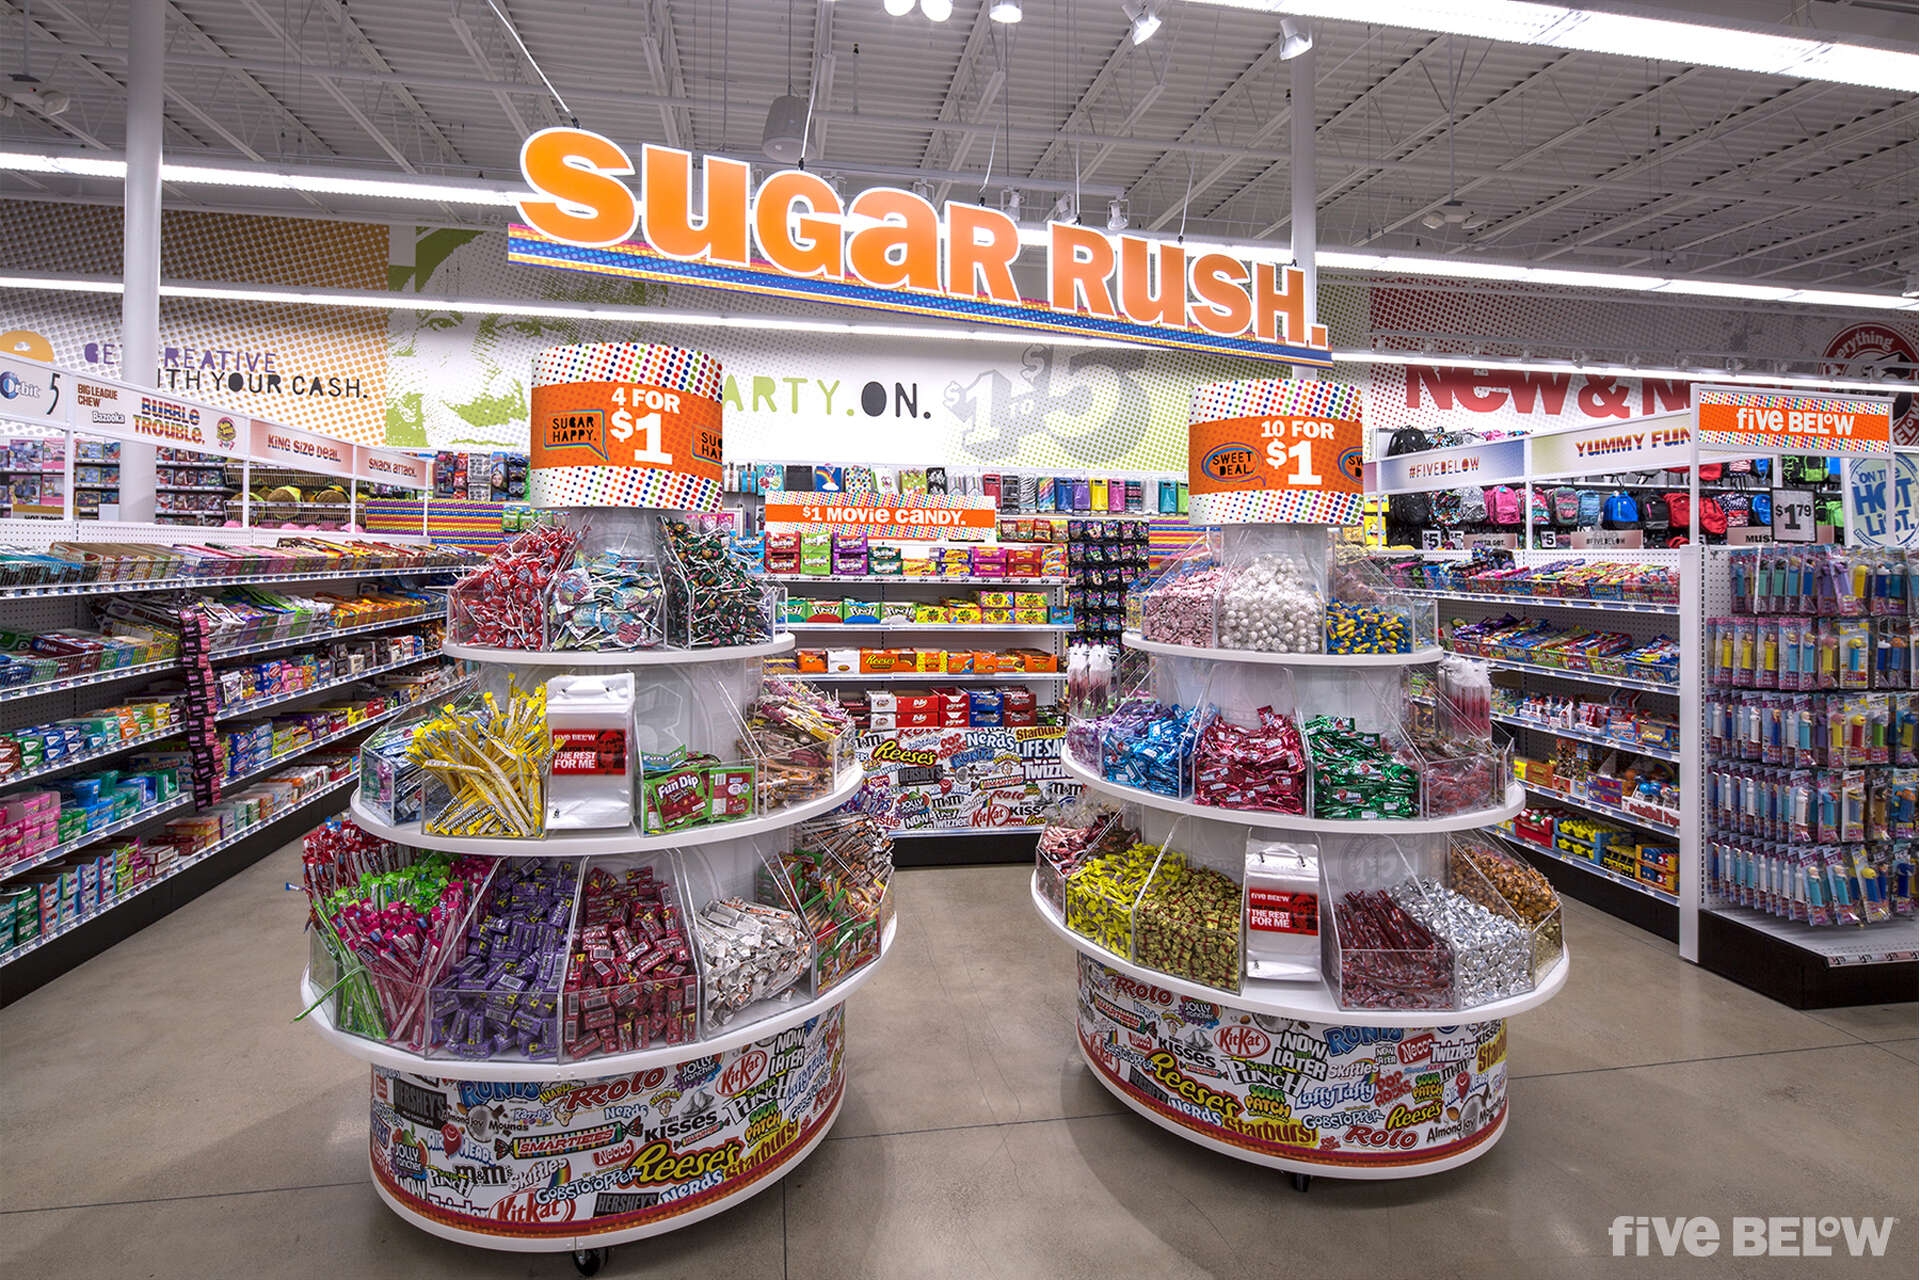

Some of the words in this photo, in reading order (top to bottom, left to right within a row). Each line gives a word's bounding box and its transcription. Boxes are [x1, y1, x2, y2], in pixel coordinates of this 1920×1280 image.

[84, 343, 123, 365] GE
[163, 347, 277, 374] REATIVE
[0, 371, 40, 399] Orbit
[46, 373, 61, 416] 5
[78, 384, 90, 395] BIG
[91, 386, 118, 400] LEAGUE
[156, 368, 200, 391] ITH
[211, 370, 281, 397] YOUR
[292, 376, 369, 400] CASH.
[1578, 372, 1630, 419] &
[78, 396, 100, 408] CHEW
[611, 386, 629, 406] 4
[632, 388, 681, 415] FOR
[92, 411, 125, 425] Bazooka
[552, 415, 595, 432] SUGAR
[1260, 420, 1286, 439] 10
[1291, 420, 1335, 440] FOR
[1737, 407, 1784, 432] five
[552, 428, 597, 445] HAPPY.
[610, 407, 673, 466] $1
[1576, 433, 1645, 457] YUMMY
[1212, 451, 1253, 467] SWEET
[1219, 464, 1255, 477] DEAL.
[1266, 440, 1322, 486] $1
[1409, 456, 1480, 478] #FIVEBELOW
[1859, 471, 1876, 483] ON
[1851, 478, 1913, 515] HOT
[802, 506, 823, 521] $1
[1423, 533, 1439, 548] $5
[554, 759, 577, 769] FOR
[580, 760, 596, 769] ME
[555, 751, 570, 760] THE
[572, 751, 596, 760] REST
[873, 740, 937, 766] Reese's
[657, 780, 679, 800] Fun
[679, 773, 699, 792] Dip
[1252, 909, 1268, 919] THE
[1269, 911, 1289, 921] REST
[1252, 917, 1272, 927] FOR
[1275, 918, 1289, 928] ME
[1283, 1031, 1328, 1060] NOW
[769, 1047, 804, 1077] LATER
[1275, 1051, 1328, 1081] LATER
[1327, 1061, 1381, 1081] Skittles
[566, 1067, 667, 1110] Rolo
[1151, 1053, 1240, 1118] Reese's
[1249, 1085, 1286, 1103] SOUR
[1245, 1096, 1292, 1118] PATCH
[1386, 1102, 1444, 1131] Reese's
[488, 1119, 530, 1132] Mounds
[1224, 1118, 1318, 1145] Starburst
[1344, 1125, 1420, 1150] Rolo
[1426, 1120, 1463, 1144] Almond
[519, 1129, 616, 1153] SMARTIES
[510, 1157, 569, 1193] Skittles
[636, 1141, 741, 1185] Reese's
